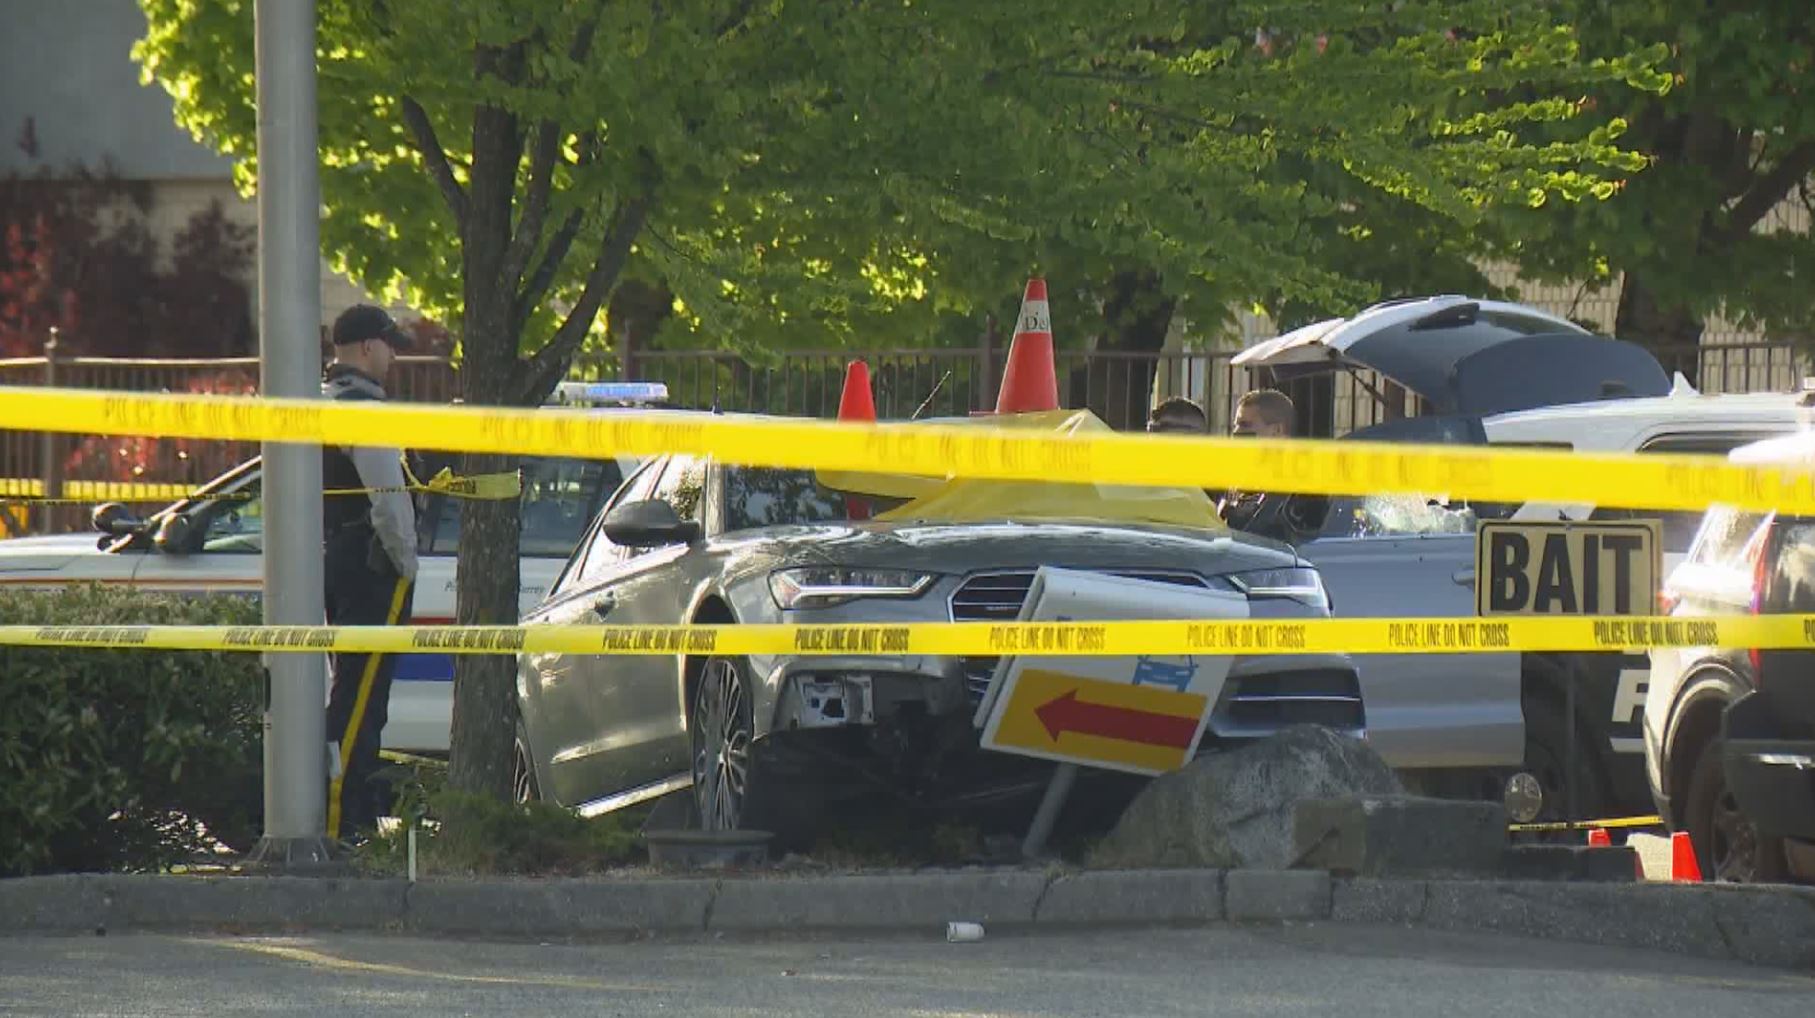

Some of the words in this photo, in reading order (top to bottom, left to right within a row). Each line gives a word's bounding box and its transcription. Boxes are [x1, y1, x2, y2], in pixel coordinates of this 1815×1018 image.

[1490, 531, 1643, 614] BAIT
[602, 629, 634, 650] POLICE
[633, 629, 656, 650] LINE
[654, 629, 669, 650] DO
[669, 629, 687, 650] NOT
[687, 629, 717, 652] CROSS
[794, 628, 824, 651] POLICE
[826, 628, 846, 651] LINE
[846, 628, 860, 651] DO
[861, 628, 880, 651] NOT
[881, 628, 910, 651] CROSS
[989, 627, 1019, 650] POLICE
[1021, 627, 1041, 650] LINE
[1042, 627, 1055, 650] DO
[1056, 627, 1075, 650] NOT
[1077, 627, 1105, 650] CROSS
[1187, 624, 1217, 648] POLICE
[1219, 624, 1238, 648] LINE
[1241, 624, 1254, 648] DO
[1255, 624, 1273, 648] NOT
[1276, 624, 1306, 648] CROSS
[1389, 623, 1419, 647] POLICE
[1421, 623, 1440, 647] LINE
[1443, 623, 1456, 647] DO
[1458, 623, 1476, 647] NOT
[1479, 623, 1510, 647] CROSS
[1593, 621, 1625, 645] POLICE
[1627, 621, 1648, 645] LINE
[1649, 621, 1664, 645] DO
[1665, 622, 1685, 646] NOT
[1687, 622, 1719, 646] CROSS
